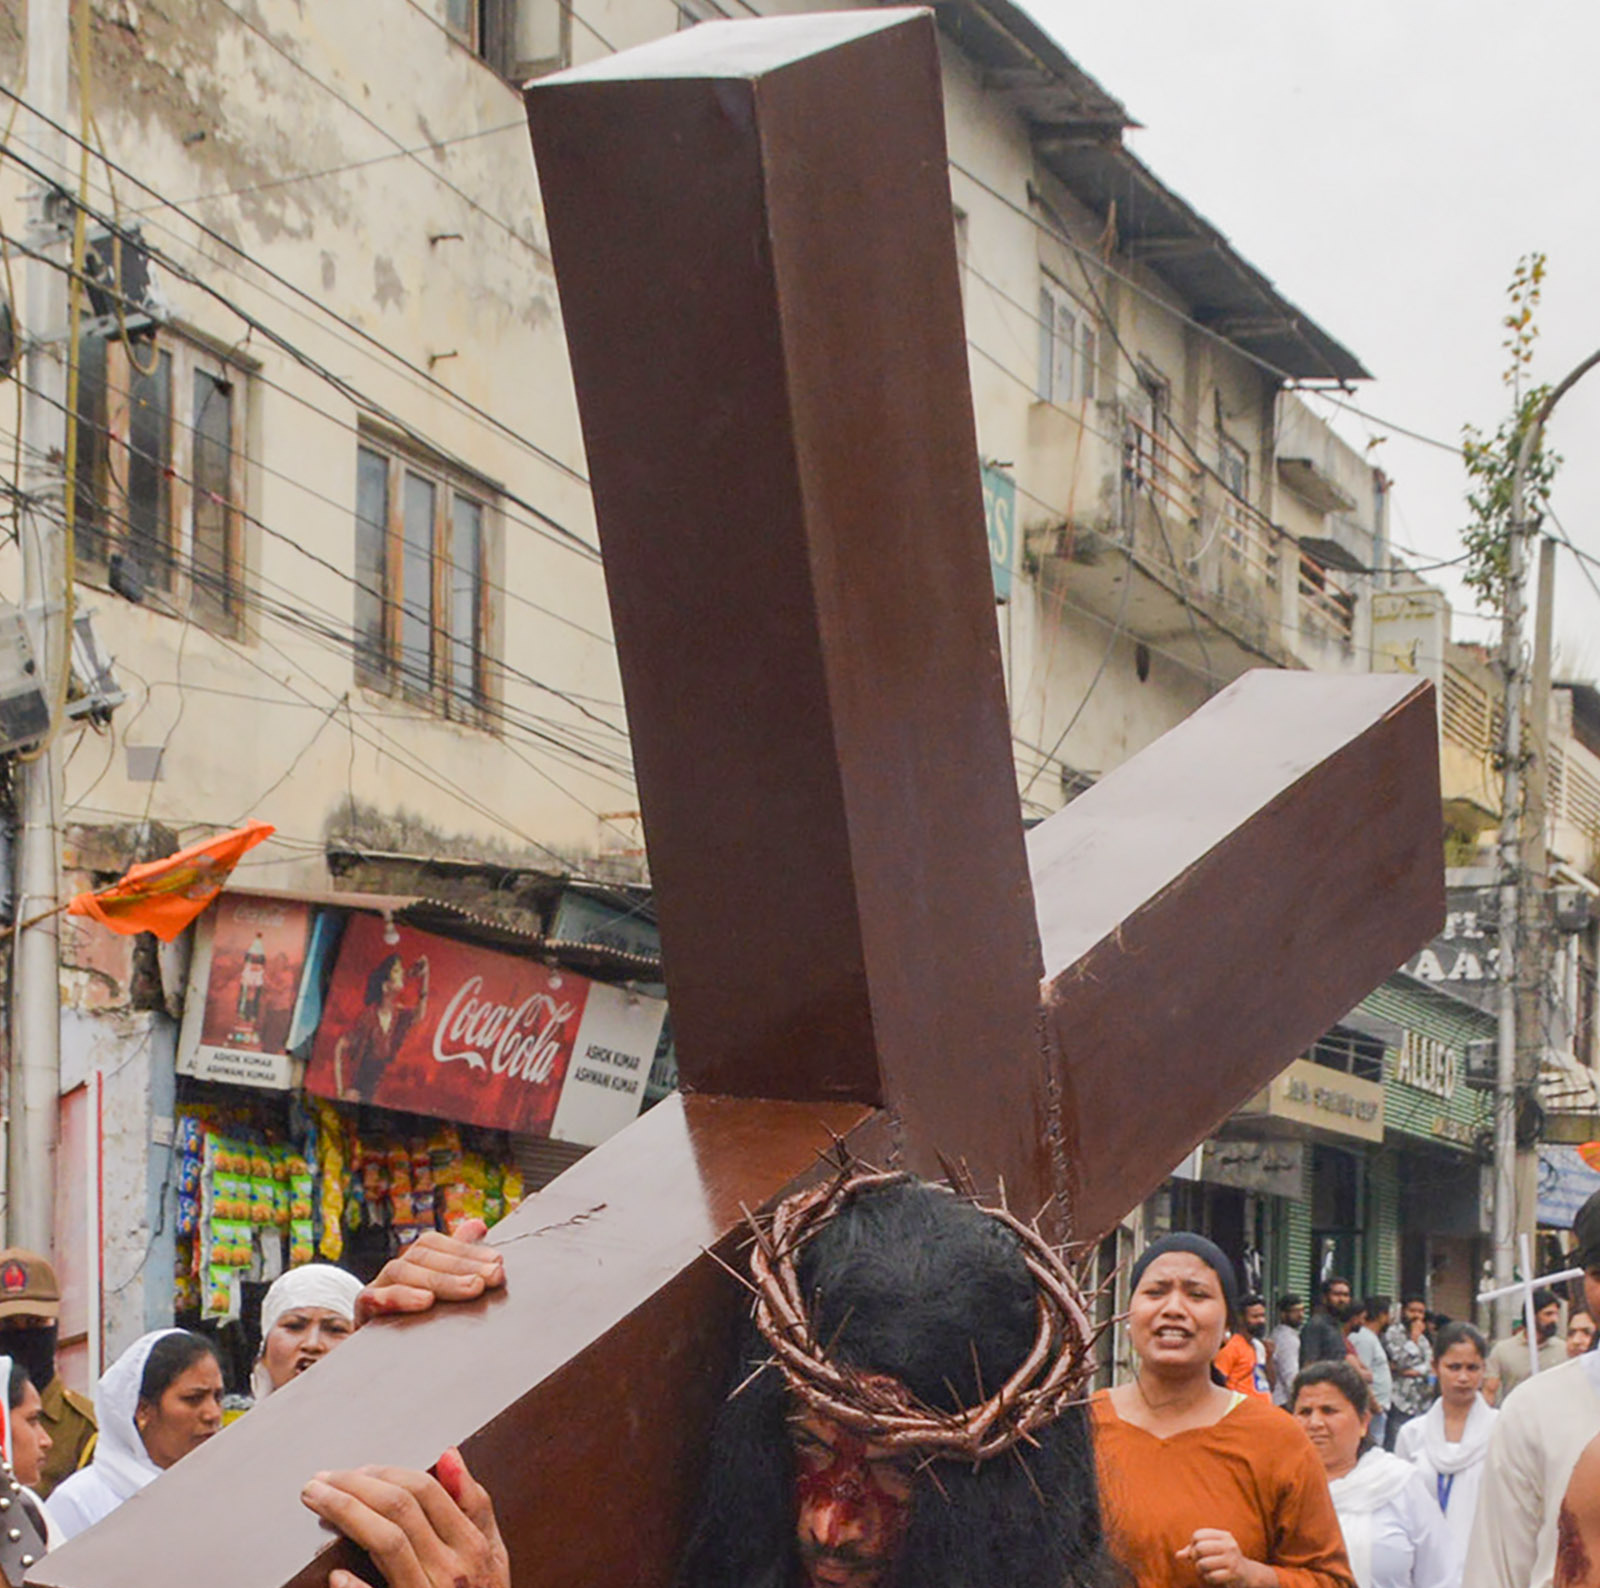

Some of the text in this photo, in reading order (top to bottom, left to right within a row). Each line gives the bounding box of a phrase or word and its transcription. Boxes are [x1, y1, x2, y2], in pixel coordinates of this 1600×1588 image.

[585, 1043, 641, 1072] ASHOK KUMAR
[611, 1076, 639, 1095] KUMAR
